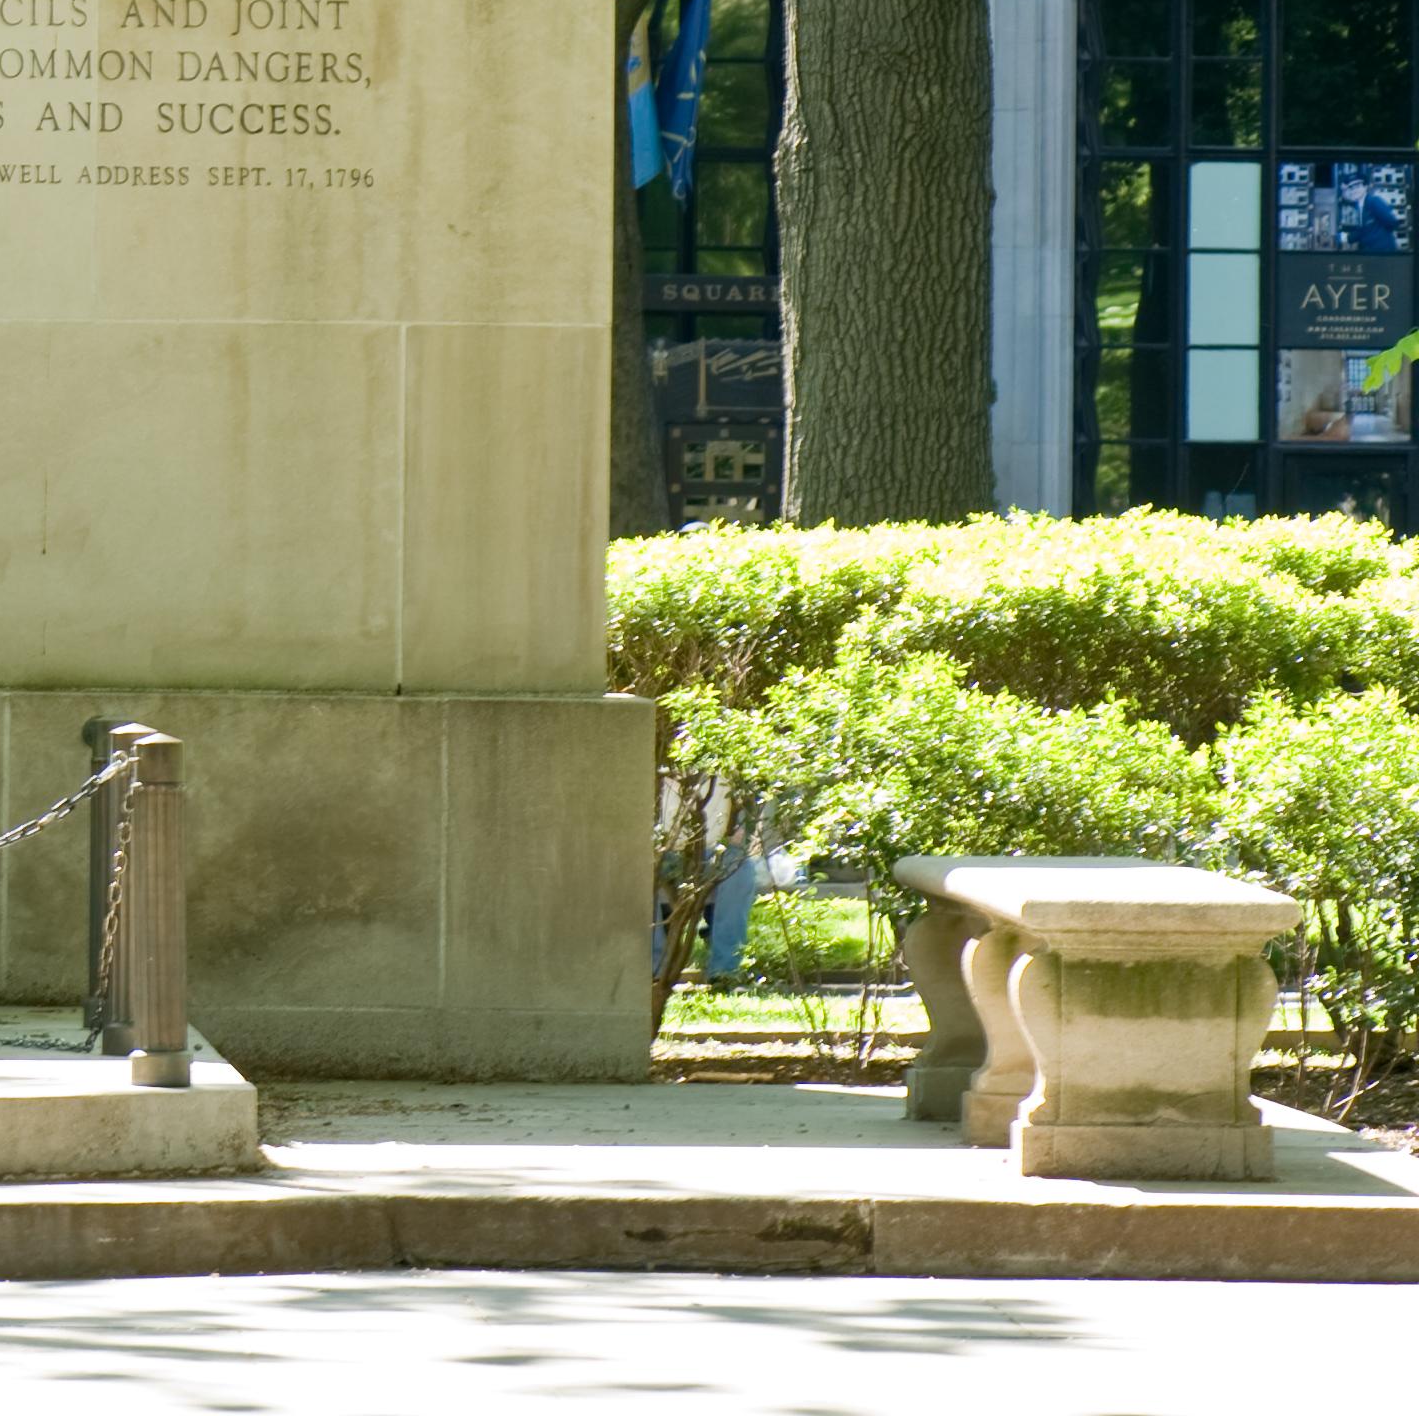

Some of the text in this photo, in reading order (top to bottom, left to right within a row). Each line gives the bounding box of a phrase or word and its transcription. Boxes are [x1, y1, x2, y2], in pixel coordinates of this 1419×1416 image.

[231, 0, 349, 36] JOINT
[178, 51, 371, 89] DANGERS,
[36, 102, 123, 132] AND
[158, 103, 340, 136] SUCCESS.
[78, 165, 189, 186] ADDRESS
[208, 166, 272, 186] SEPT.
[286, 168, 314, 190] 17,
[325, 168, 374, 188] 1796
[1300, 284, 1390, 310] AYER
